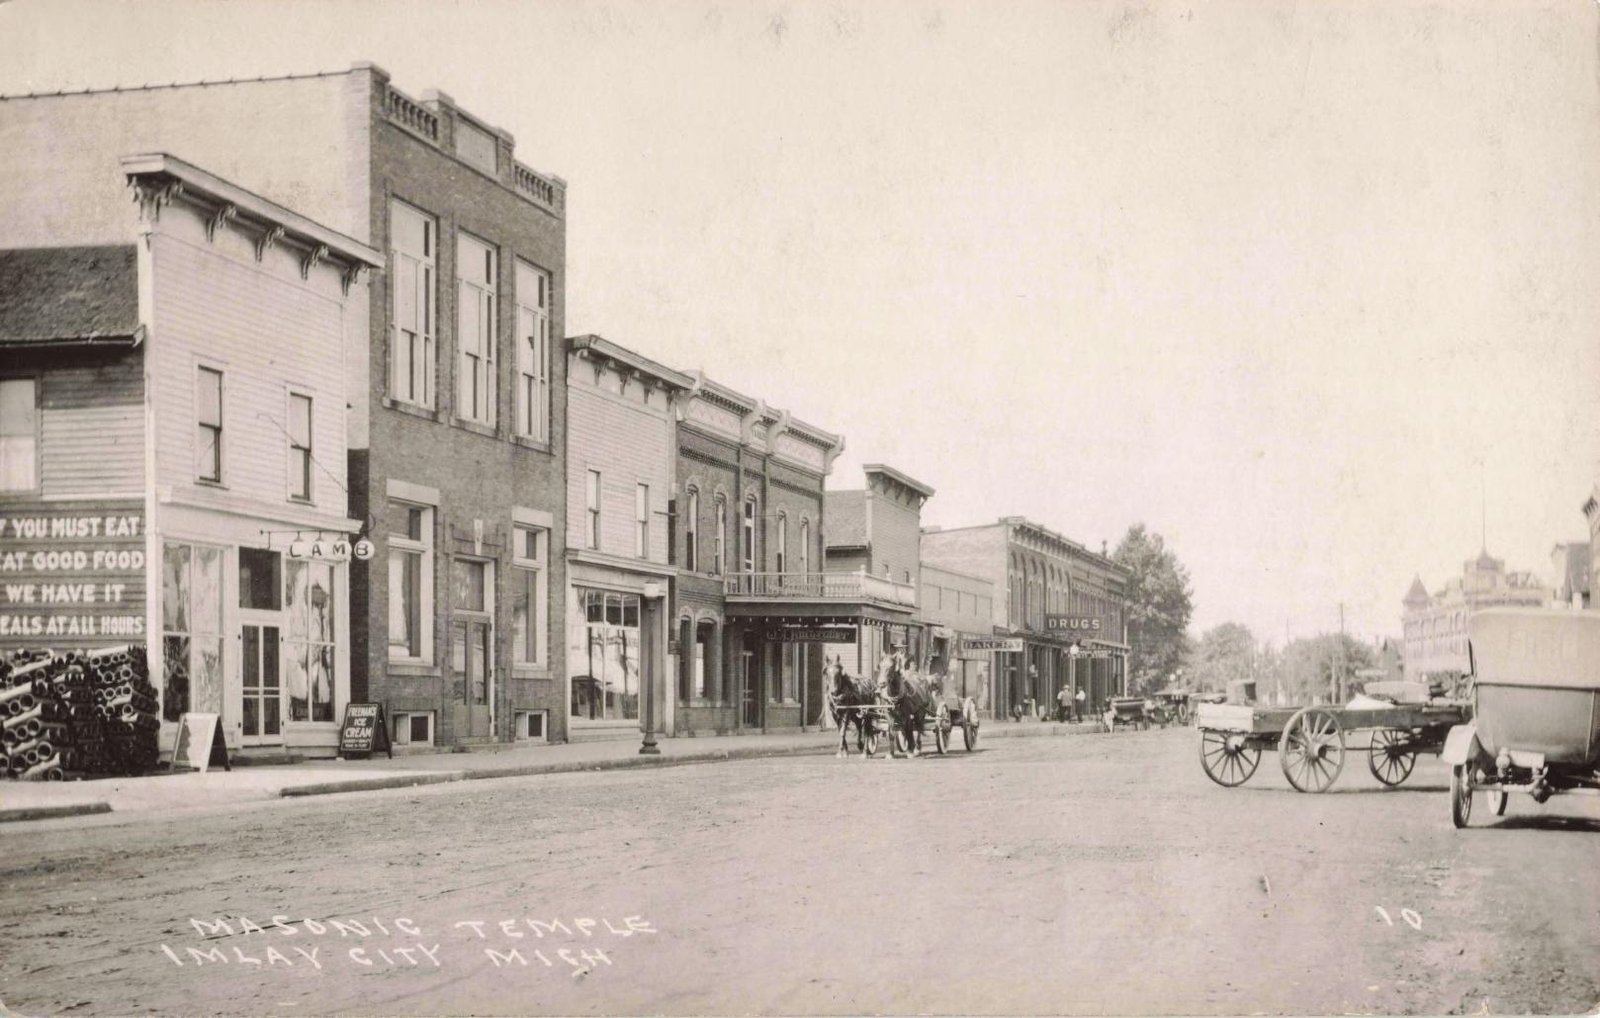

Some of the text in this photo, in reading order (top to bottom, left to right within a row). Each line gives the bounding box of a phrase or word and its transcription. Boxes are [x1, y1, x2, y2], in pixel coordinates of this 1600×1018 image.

[12, 517, 47, 538] YOU
[51, 517, 101, 538] MUST
[105, 516, 140, 537] EAT
[0, 551, 144, 571] AT GOOD FOOD
[6, 584, 125, 603] WE HAVE IT
[46, 616, 68, 635] AT
[68, 616, 96, 635] ALL
[101, 615, 144, 635] HOURS
[1049, 618, 1100, 630] DRUGS
[353, 717, 367, 727] ICE
[345, 727, 372, 738] CREAM
